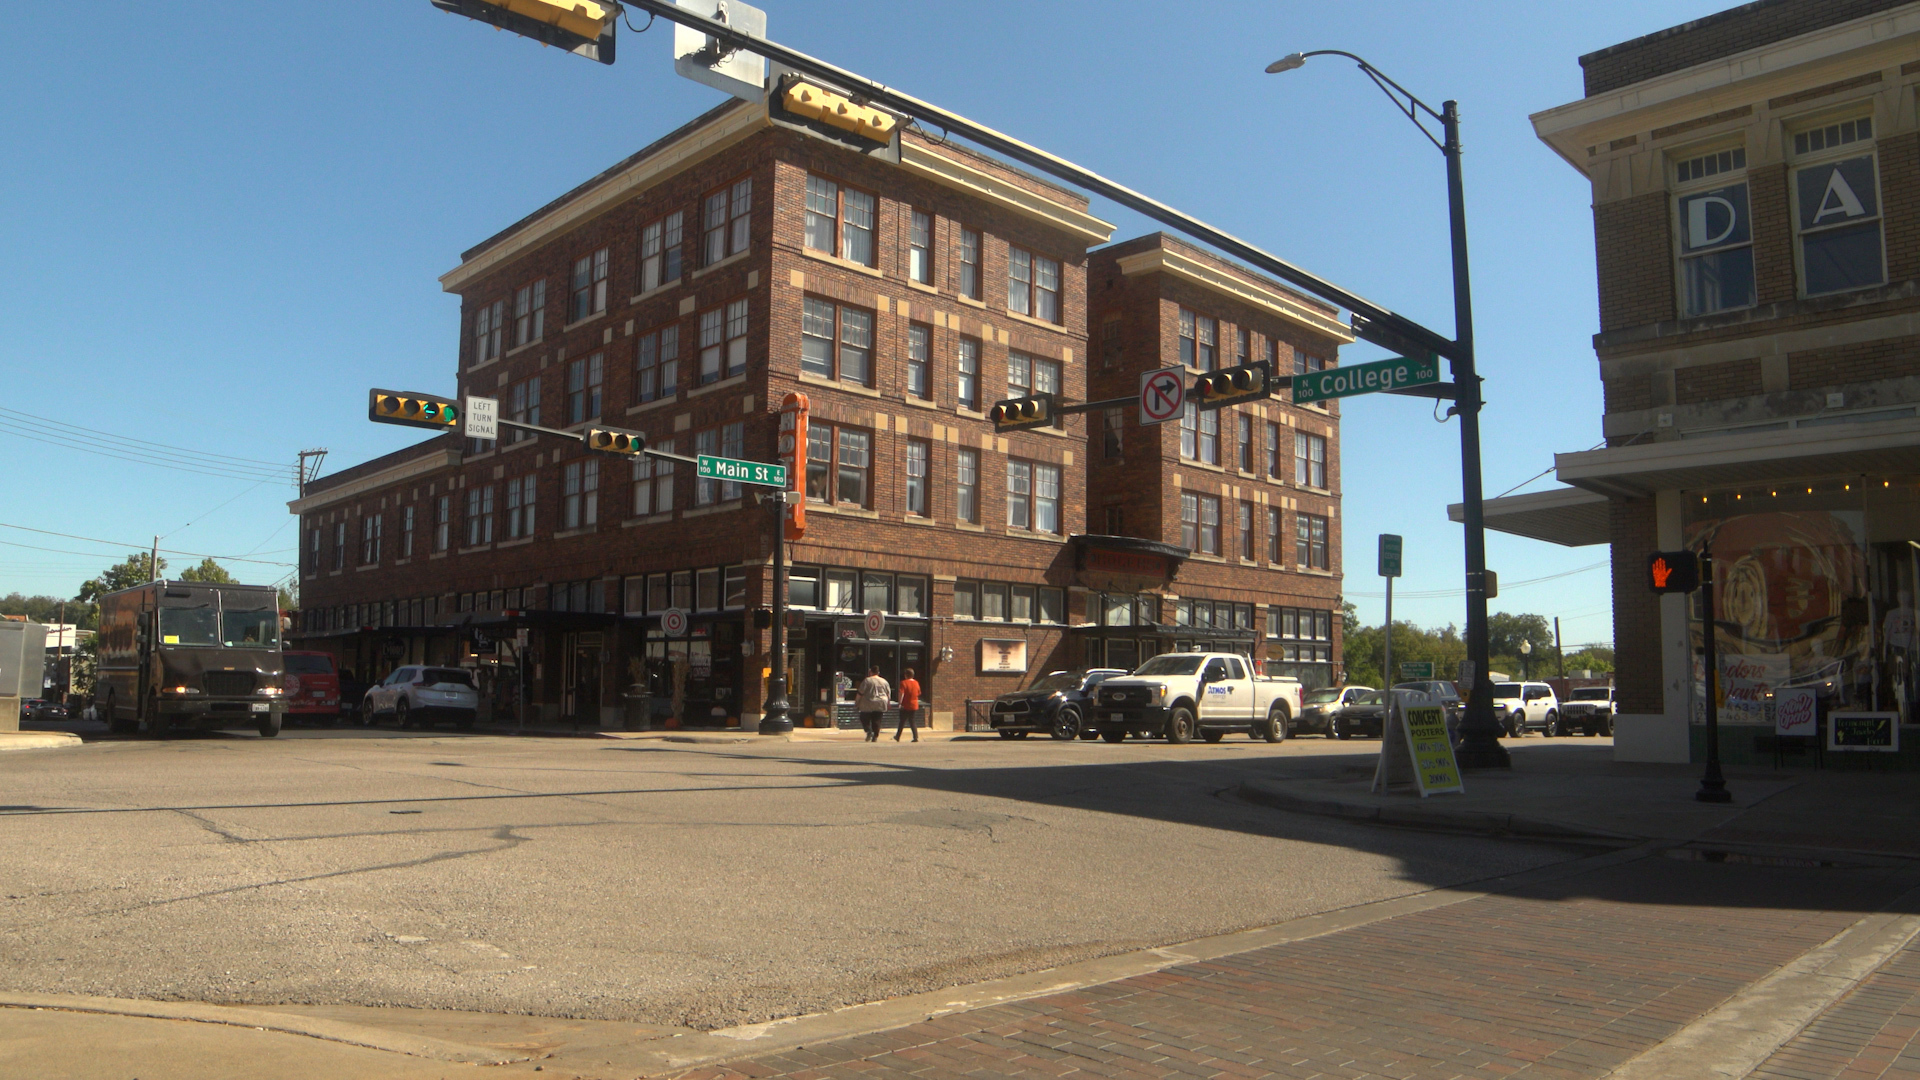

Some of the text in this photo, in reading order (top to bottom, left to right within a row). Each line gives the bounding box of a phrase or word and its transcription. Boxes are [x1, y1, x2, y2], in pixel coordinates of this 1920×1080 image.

[1415, 369, 1433, 380] 100
[1302, 379, 1309, 388] N
[1320, 365, 1408, 395] College
[1298, 388, 1314, 398] 100
[473, 401, 491, 411] LEFT
[472, 413, 492, 423] TURN
[468, 424, 495, 435] SIGNAL
[700, 466, 711, 474] 100
[716, 461, 768, 481] Main St
[842, 629, 857, 638] OPEN
[1407, 709, 1441, 726] CONCERT
[1411, 727, 1445, 737] POSTERS
